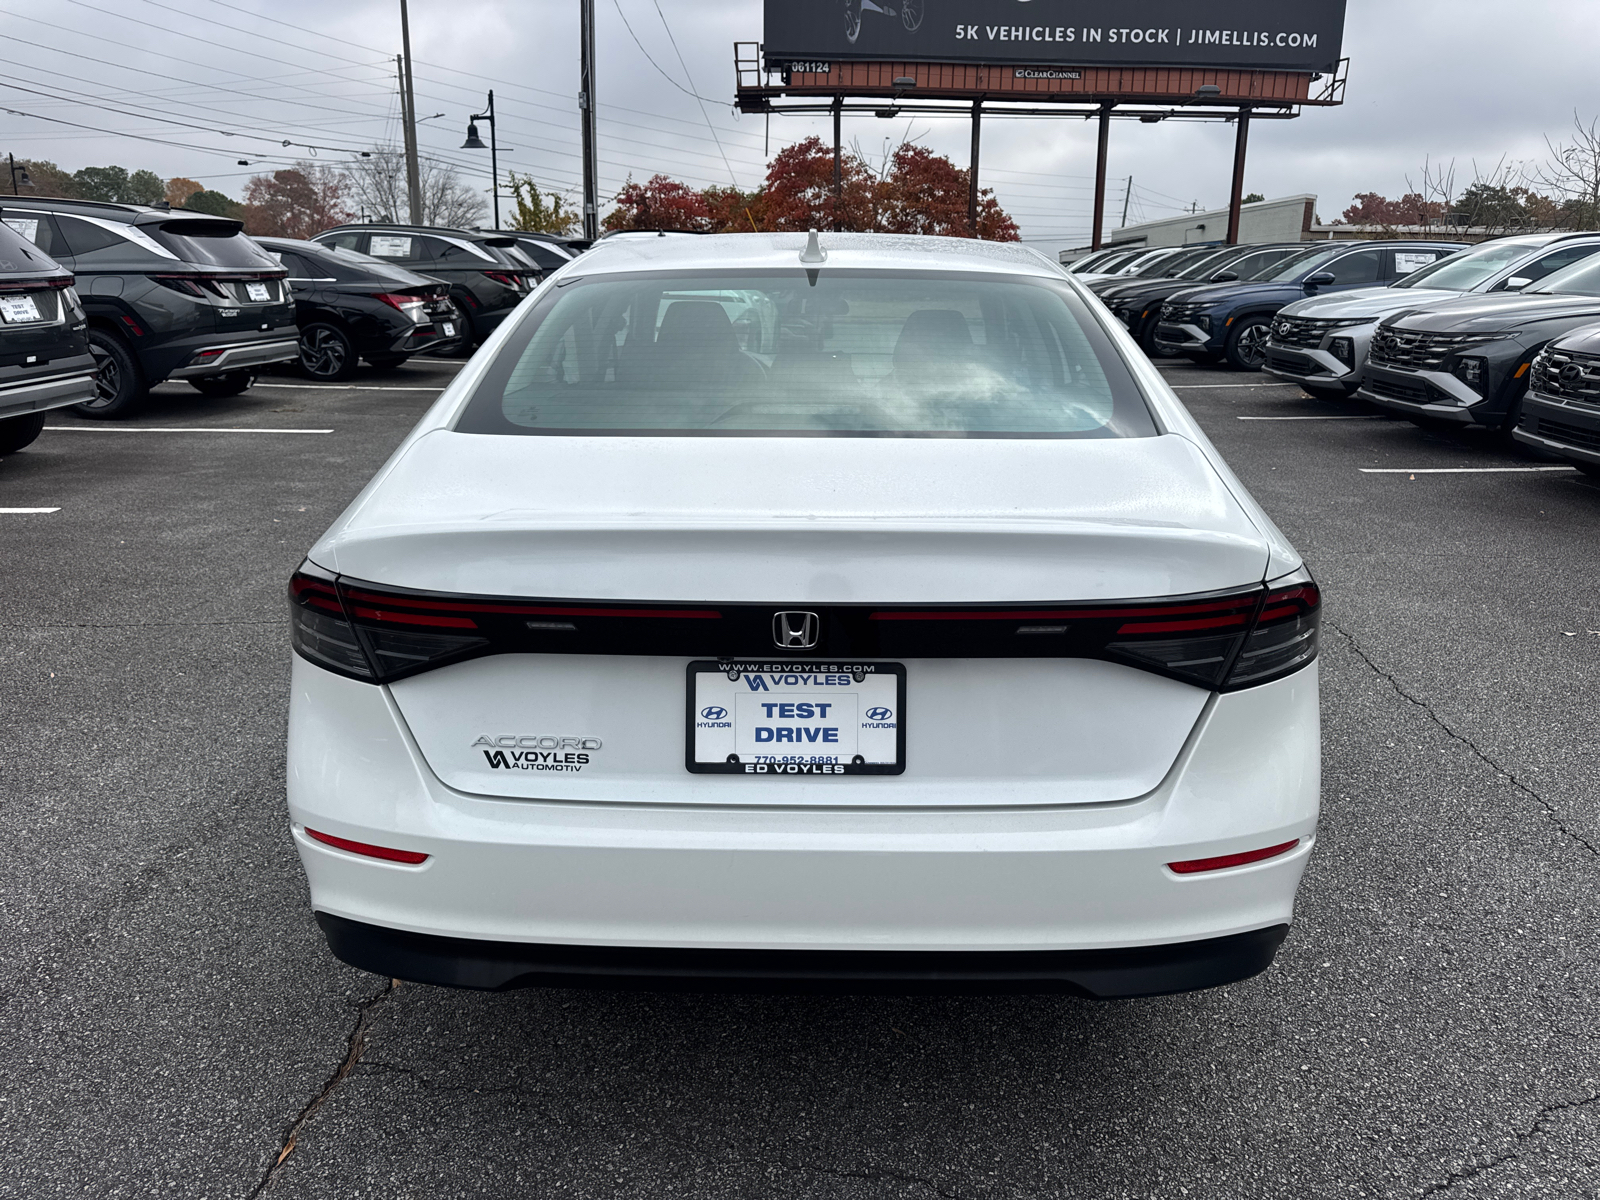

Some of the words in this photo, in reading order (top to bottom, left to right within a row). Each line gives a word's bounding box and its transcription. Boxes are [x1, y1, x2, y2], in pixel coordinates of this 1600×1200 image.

[955, 24, 979, 40] 5K
[985, 25, 1076, 42] VEHICLES
[1082, 27, 1102, 43] IN
[1108, 28, 1170, 43] STOCK
[1188, 29, 1318, 48] JIMELLIS.COM
[791, 61, 829, 72] 061124
[718, 663, 875, 672] WWW.EDVOYLES.COM
[769, 674, 851, 686] VOYLES
[761, 702, 832, 719] TEST
[755, 727, 839, 743] DRIVE
[471, 735, 603, 751] ACCORD
[510, 751, 590, 765] VOYLES
[754, 755, 839, 764] 770-952-8881
[511, 762, 582, 772] AUTOMOTIV
[745, 764, 768, 773] ED
[774, 764, 845, 774] VOYLES
